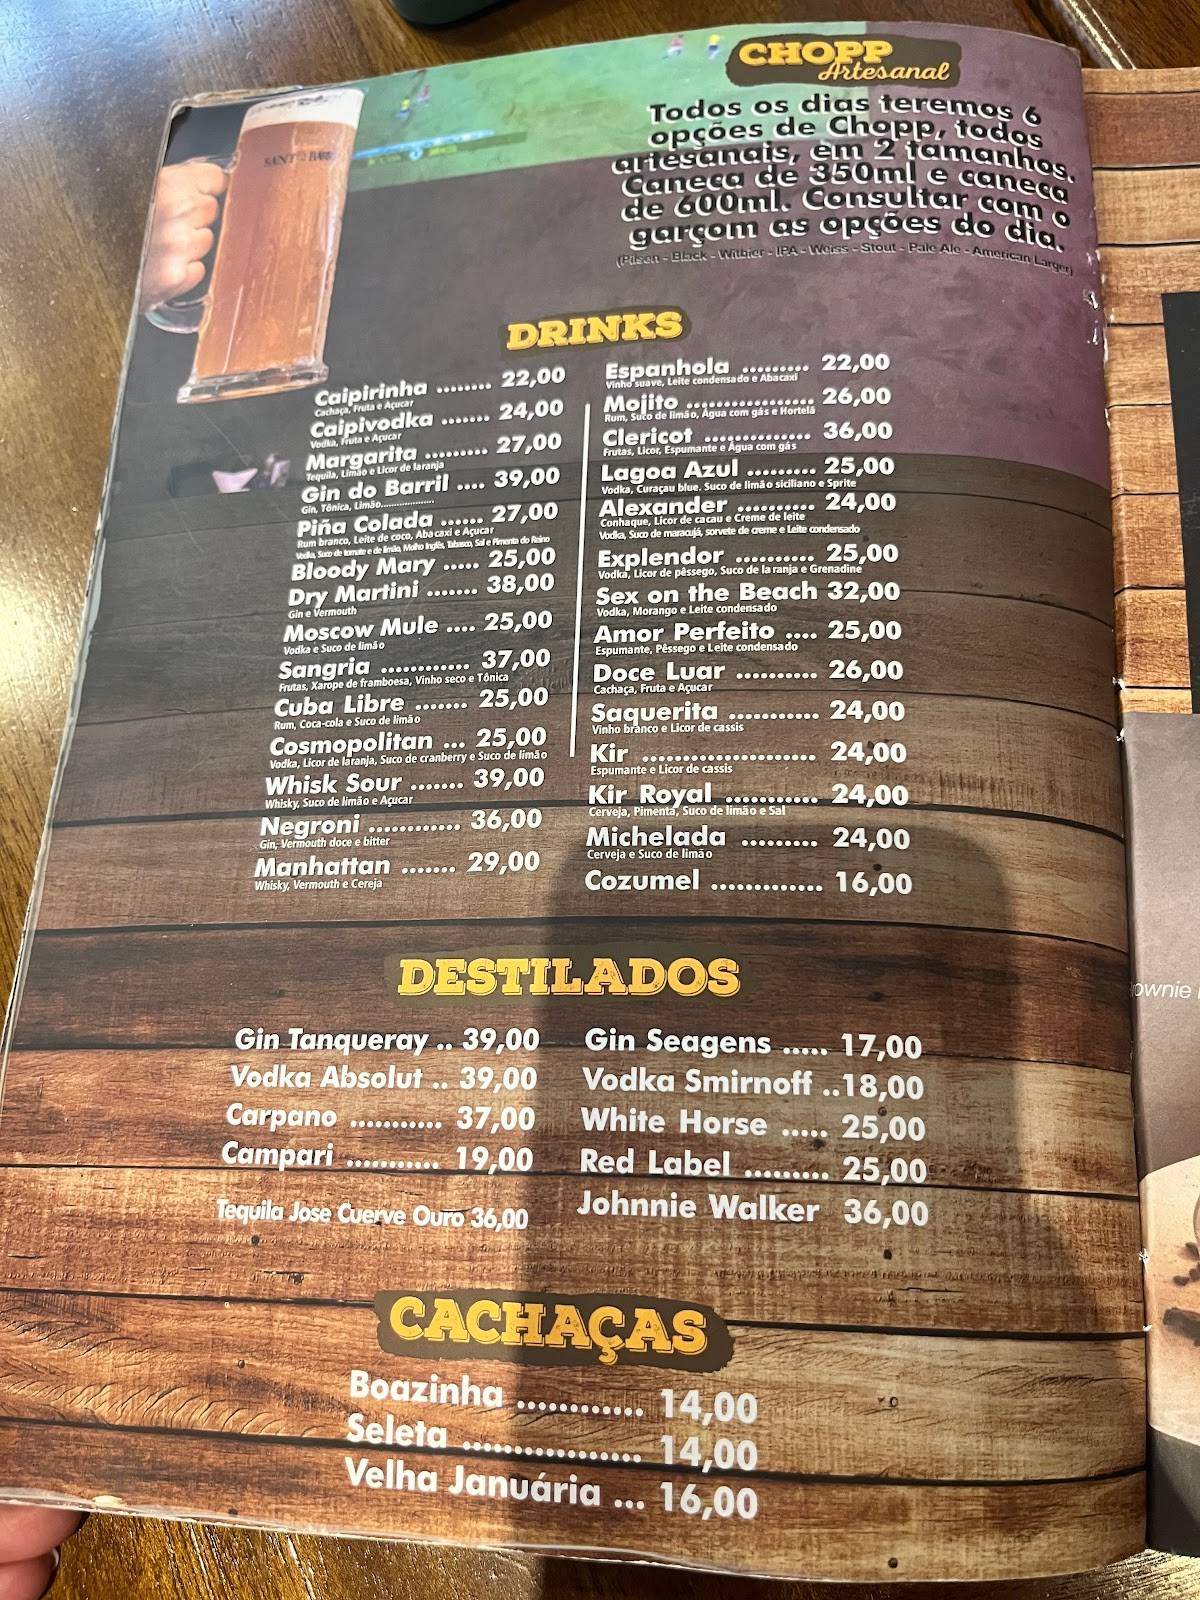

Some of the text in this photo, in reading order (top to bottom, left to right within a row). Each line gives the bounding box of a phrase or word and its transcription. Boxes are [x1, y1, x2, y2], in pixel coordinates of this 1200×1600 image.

[738, 40, 894, 66] CHOPP
[817, 61, 950, 82] Artesanal
[647, 93, 1041, 126] Todos os dias teremos 6
[650, 114, 1043, 151] opções de Chopp, todos
[611, 139, 1075, 184] artesanais, em 2 tamanhos.
[621, 161, 1069, 204] Caneca de 350ml e caneca
[620, 184, 1071, 229] de 600ml. Consultar com o
[628, 211, 1066, 252] garçom as opções do dia.
[507, 311, 682, 350] DRINKS
[605, 354, 890, 382] Espanhola 22,00
[606, 380, 632, 389] Vinho
[634, 379, 665, 388] suave,
[667, 377, 690, 386] Leite
[692, 374, 750, 385] condensado
[760, 372, 798, 382] Abacaxi
[314, 366, 566, 408] Caipirinha 22,00
[604, 388, 892, 416] Mojito 26,00
[602, 422, 893, 447] Clericot 36,00
[306, 433, 562, 472] Margarita 27,00
[297, 502, 559, 537] Piña Colada 27,00
[283, 610, 553, 642] Moscow Mule 25,00
[288, 610, 304, 619] Gin
[314, 606, 357, 616] Vermouth
[594, 620, 902, 644] Amor Perfeito 25,00
[278, 649, 551, 680] Sangria 37,00
[593, 660, 904, 682] Doce Luar 26,00
[279, 682, 309, 692] Frutas,
[311, 680, 345, 691] Xarope
[347, 678, 358, 688] de
[360, 676, 412, 688] framboesa,
[416, 674, 442, 684] Vinho
[444, 674, 466, 683] seco
[477, 672, 509, 682] Tônica
[594, 682, 712, 696] Cachaça, Fruta e Açucar
[274, 714, 420, 730] Rum, Coca-cola e Suco de limão
[591, 700, 905, 726] Saquerita 24,00
[269, 727, 547, 757] Cosmopolitan 25,00
[591, 763, 733, 776] Espumante e Licor de cassis
[260, 808, 543, 839] Negroni 36,00
[586, 825, 911, 851] Michelada 24,00
[588, 848, 713, 861] Cerveja e Suco de limão
[585, 869, 913, 897] Cozumel 16,00
[397, 956, 741, 998] DESTILADOS
[235, 1027, 540, 1056] Gin Tanqueray 39,00
[585, 1028, 922, 1061] Gin Seagens 17,00
[231, 1065, 538, 1093] Vodka Absolut 39,00
[226, 1103, 536, 1134] Carpano 37,00
[581, 1107, 926, 1143] White Horse 25,00
[221, 1141, 533, 1175] Campari 19,00
[580, 1148, 927, 1185] Red Label 25,00
[216, 1200, 529, 1232] Tequila Jose Cuerve Ouro 36,00
[577, 1190, 929, 1228] Johnnie Walker 36,00
[390, 1295, 708, 1366] CACHAÇAS
[350, 1369, 758, 1426] Boazinha 14,00
[346, 1412, 758, 1473] Seleta 14,00
[344, 1456, 758, 1520] Velha Januária 16,00
